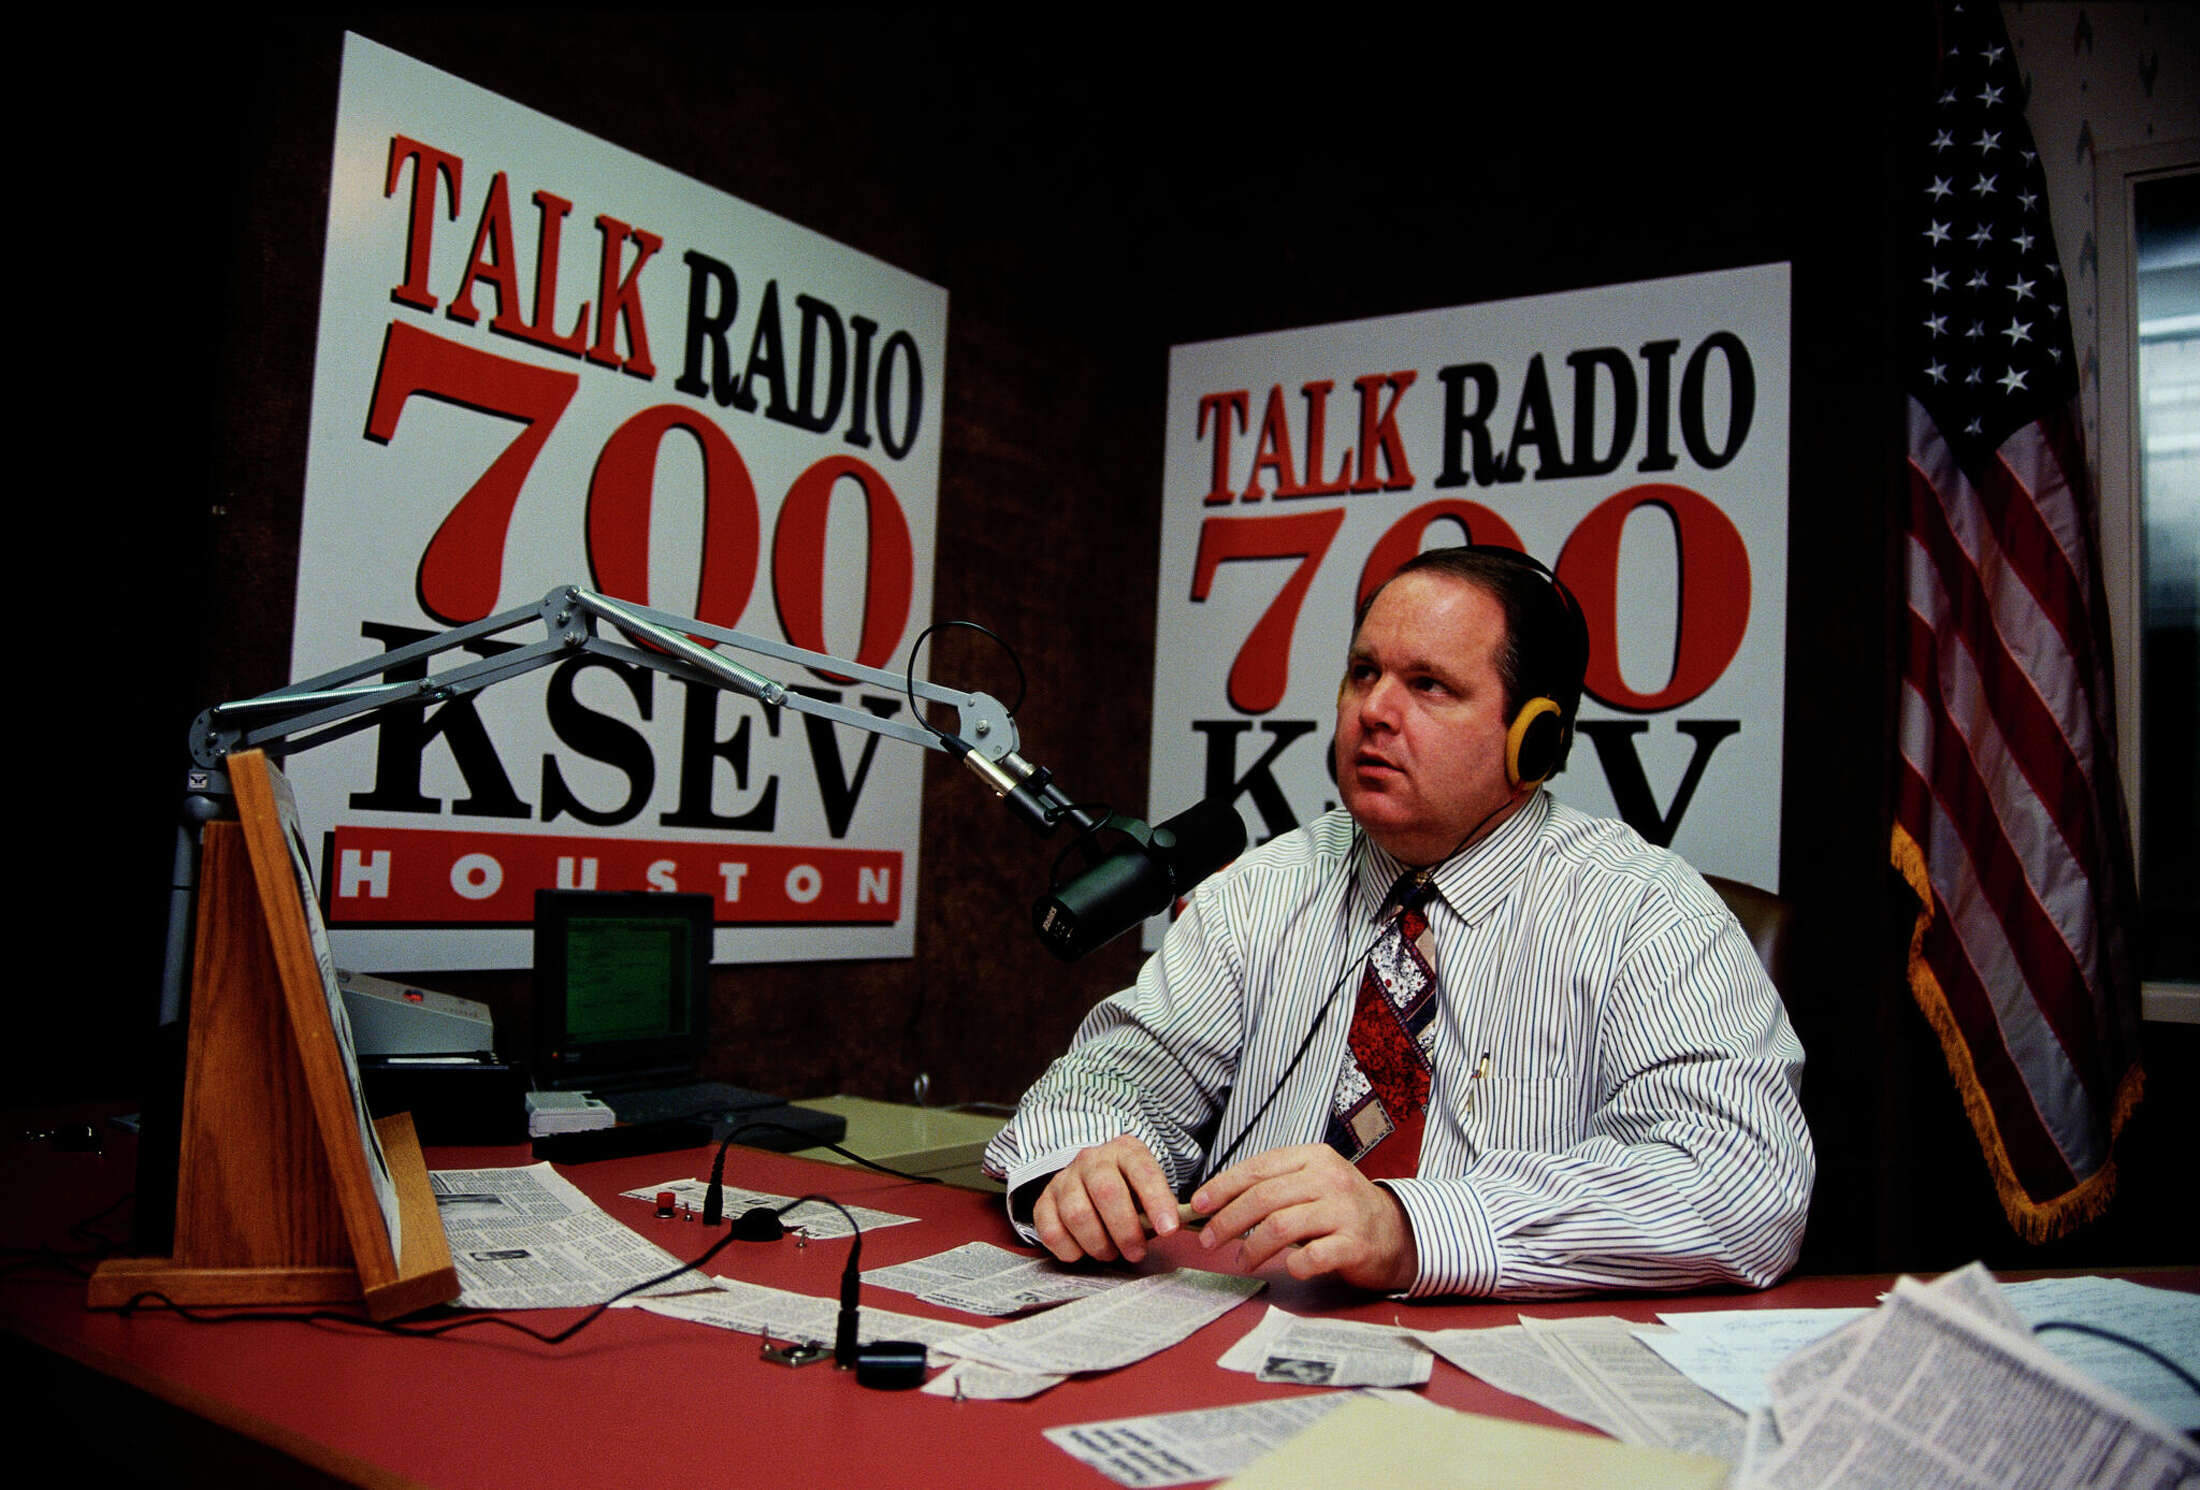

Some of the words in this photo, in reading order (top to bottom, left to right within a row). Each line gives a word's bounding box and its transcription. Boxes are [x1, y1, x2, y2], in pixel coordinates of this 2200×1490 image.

[384, 133, 663, 382] TALK
[674, 249, 923, 461] RADIO
[363, 319, 914, 686] 700
[1197, 369, 1418, 506] TALK
[1434, 331, 1756, 489] RADIO
[348, 620, 902, 839] KSEV
[1192, 719, 1741, 849] KV
[337, 848, 891, 904] HOUSTON
